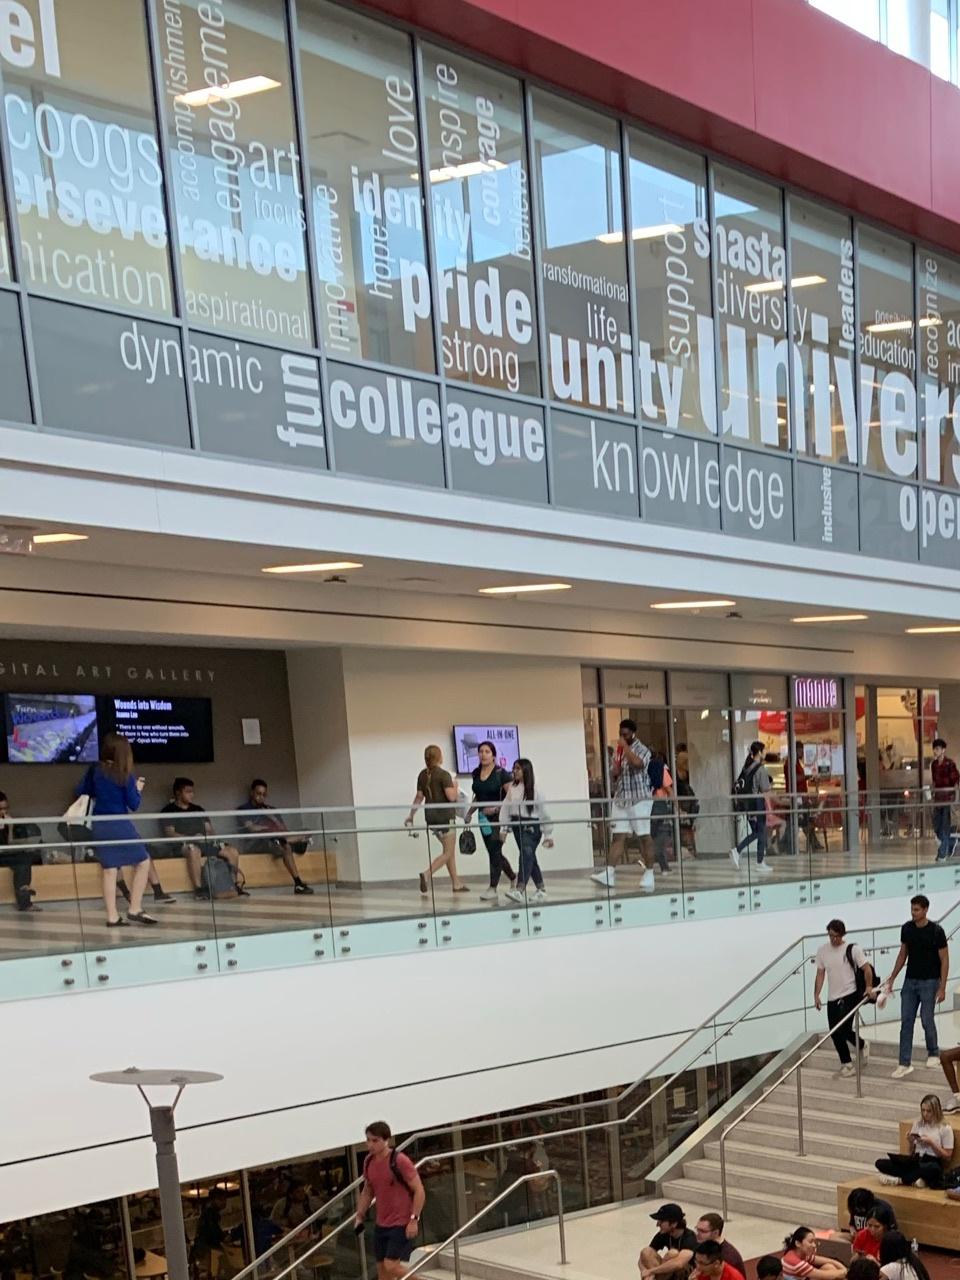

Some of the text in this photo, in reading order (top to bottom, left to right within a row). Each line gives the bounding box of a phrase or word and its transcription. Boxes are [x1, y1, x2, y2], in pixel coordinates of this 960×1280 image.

[4, 93, 163, 193] coogs
[198, 0, 246, 213] engageme
[382, 75, 418, 166] love
[432, 64, 467, 178] nspire
[249, 141, 303, 199] art
[476, 96, 500, 227] courage
[351, 166, 471, 258] idenity
[693, 216, 786, 281] shasta
[369, 224, 395, 300] hope
[400, 257, 532, 344] pride
[543, 261, 629, 304] ransformational
[837, 237, 855, 350] leaders
[186, 289, 309, 340] aspirational
[587, 302, 618, 345] life
[716, 269, 808, 346] diversity
[858, 332, 916, 370] education
[923, 258, 943, 378] recognize
[120, 322, 264, 394] dynamic
[277, 353, 324, 449] fun
[442, 331, 520, 392] strong
[549, 332, 685, 439] unity
[329, 375, 545, 466] colleague
[589, 420, 785, 530] knowledge
[820, 466, 834, 544] inclusive
[76, 665, 112, 678] ART
[127, 667, 216, 682] GALLERY
